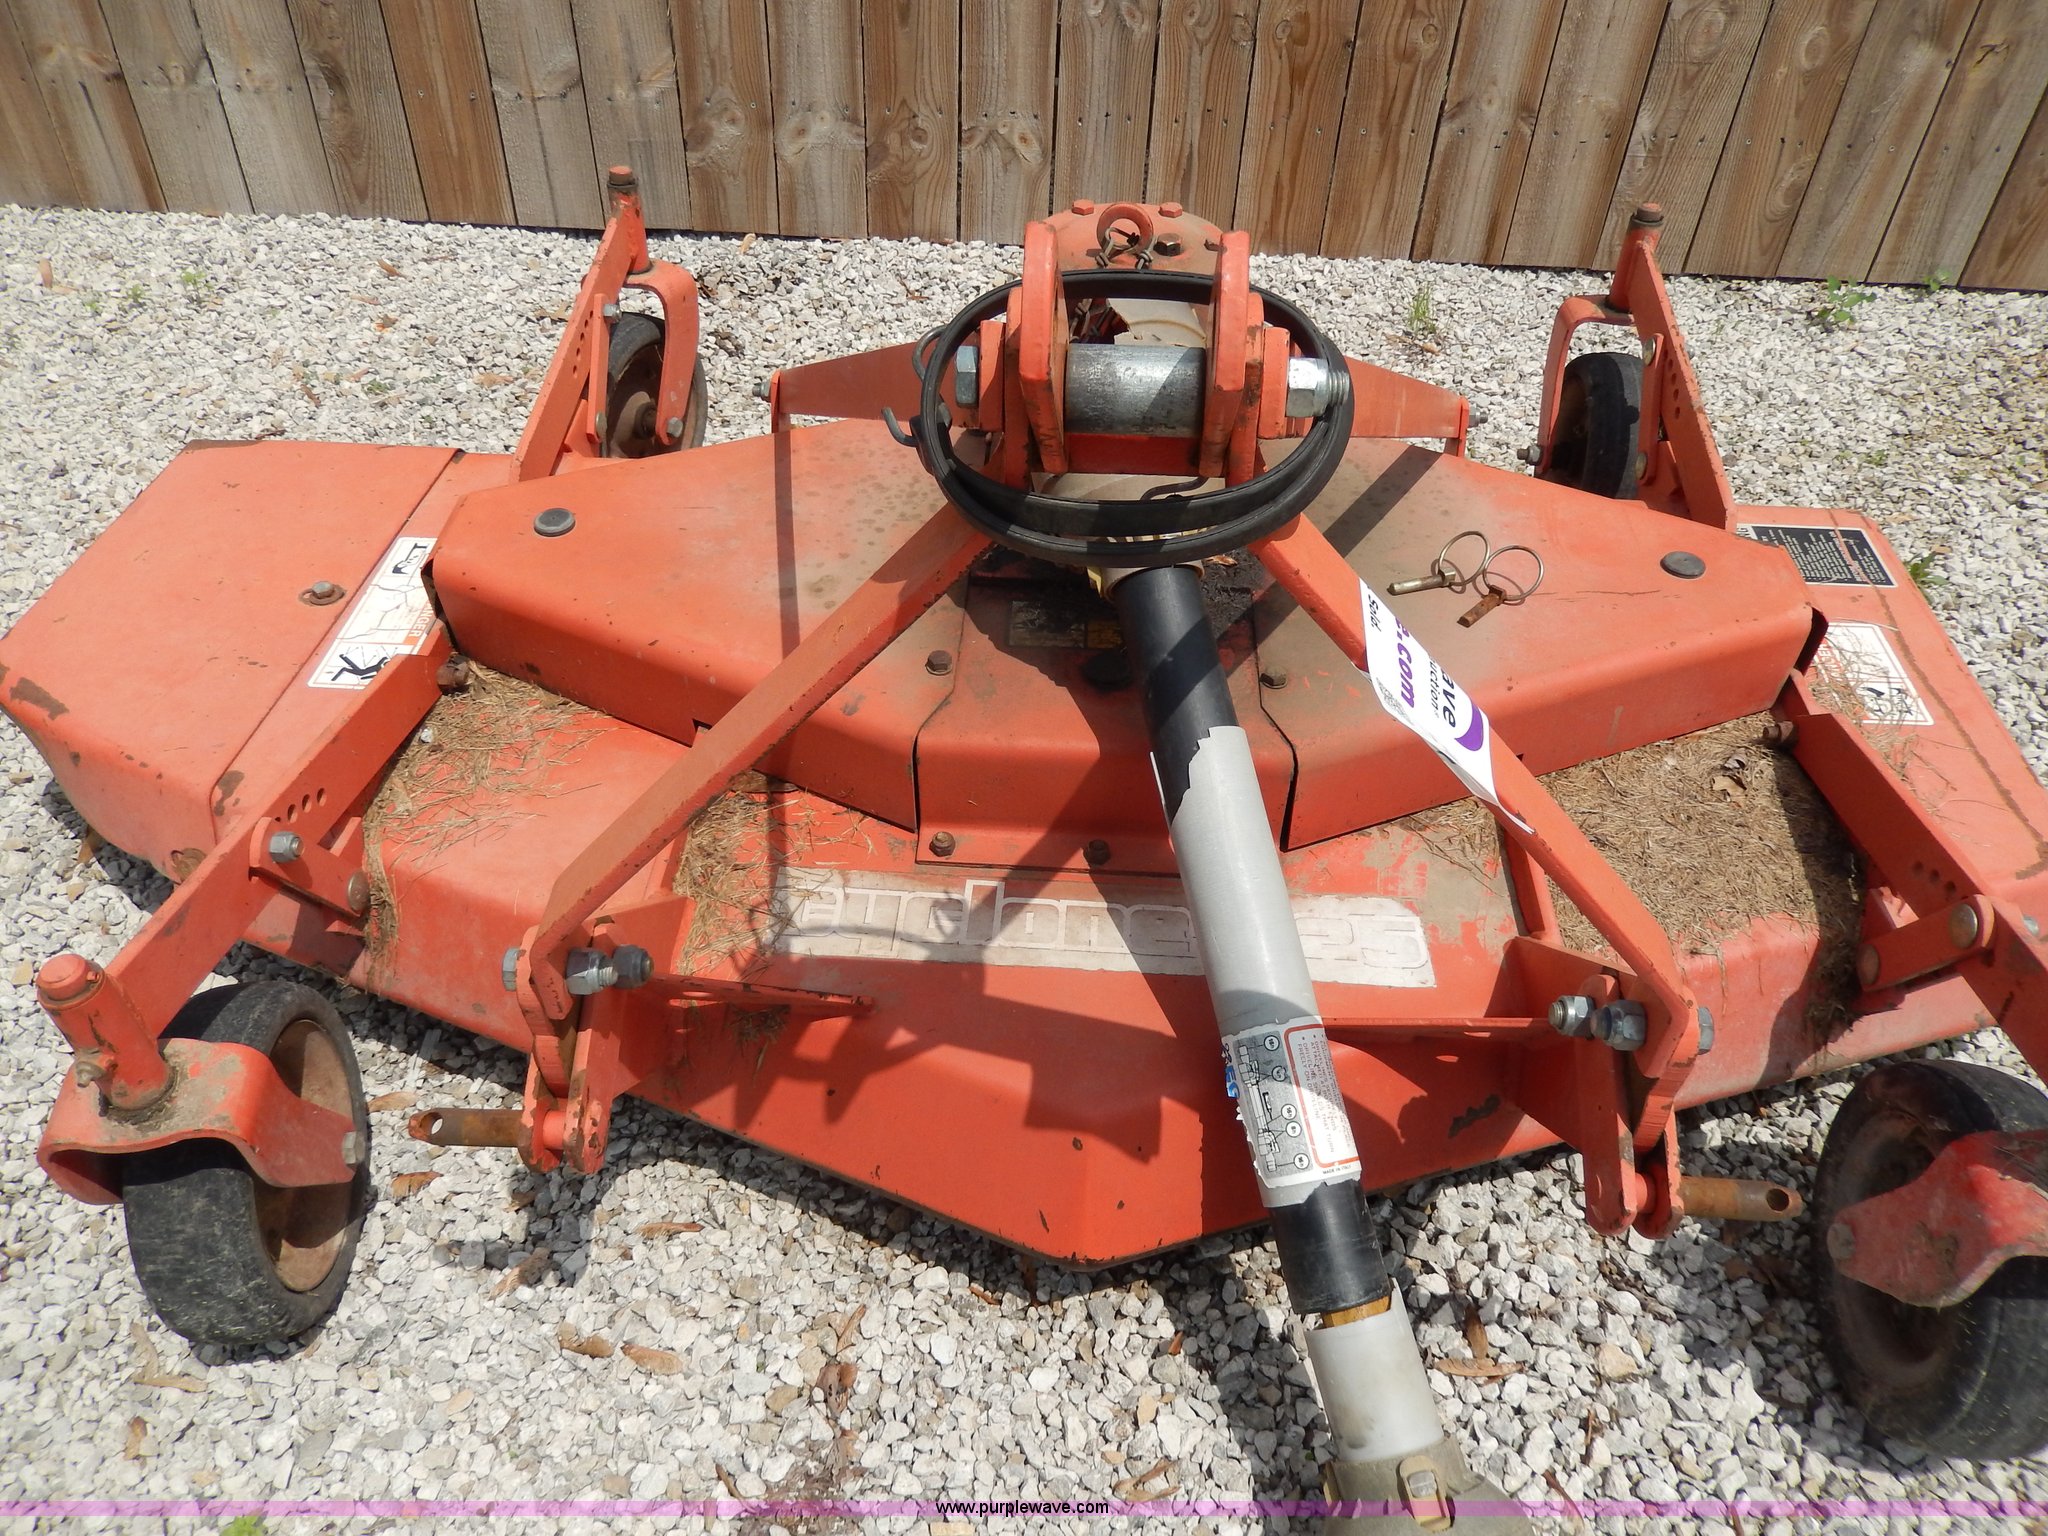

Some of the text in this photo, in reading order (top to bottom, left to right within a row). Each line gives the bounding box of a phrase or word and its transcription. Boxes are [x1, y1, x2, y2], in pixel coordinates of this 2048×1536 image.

[409, 600, 433, 637] ANGER
[1369, 599, 1381, 632] Sold.
[1395, 617, 1414, 709] e.com
[1441, 668, 1456, 728] ave
